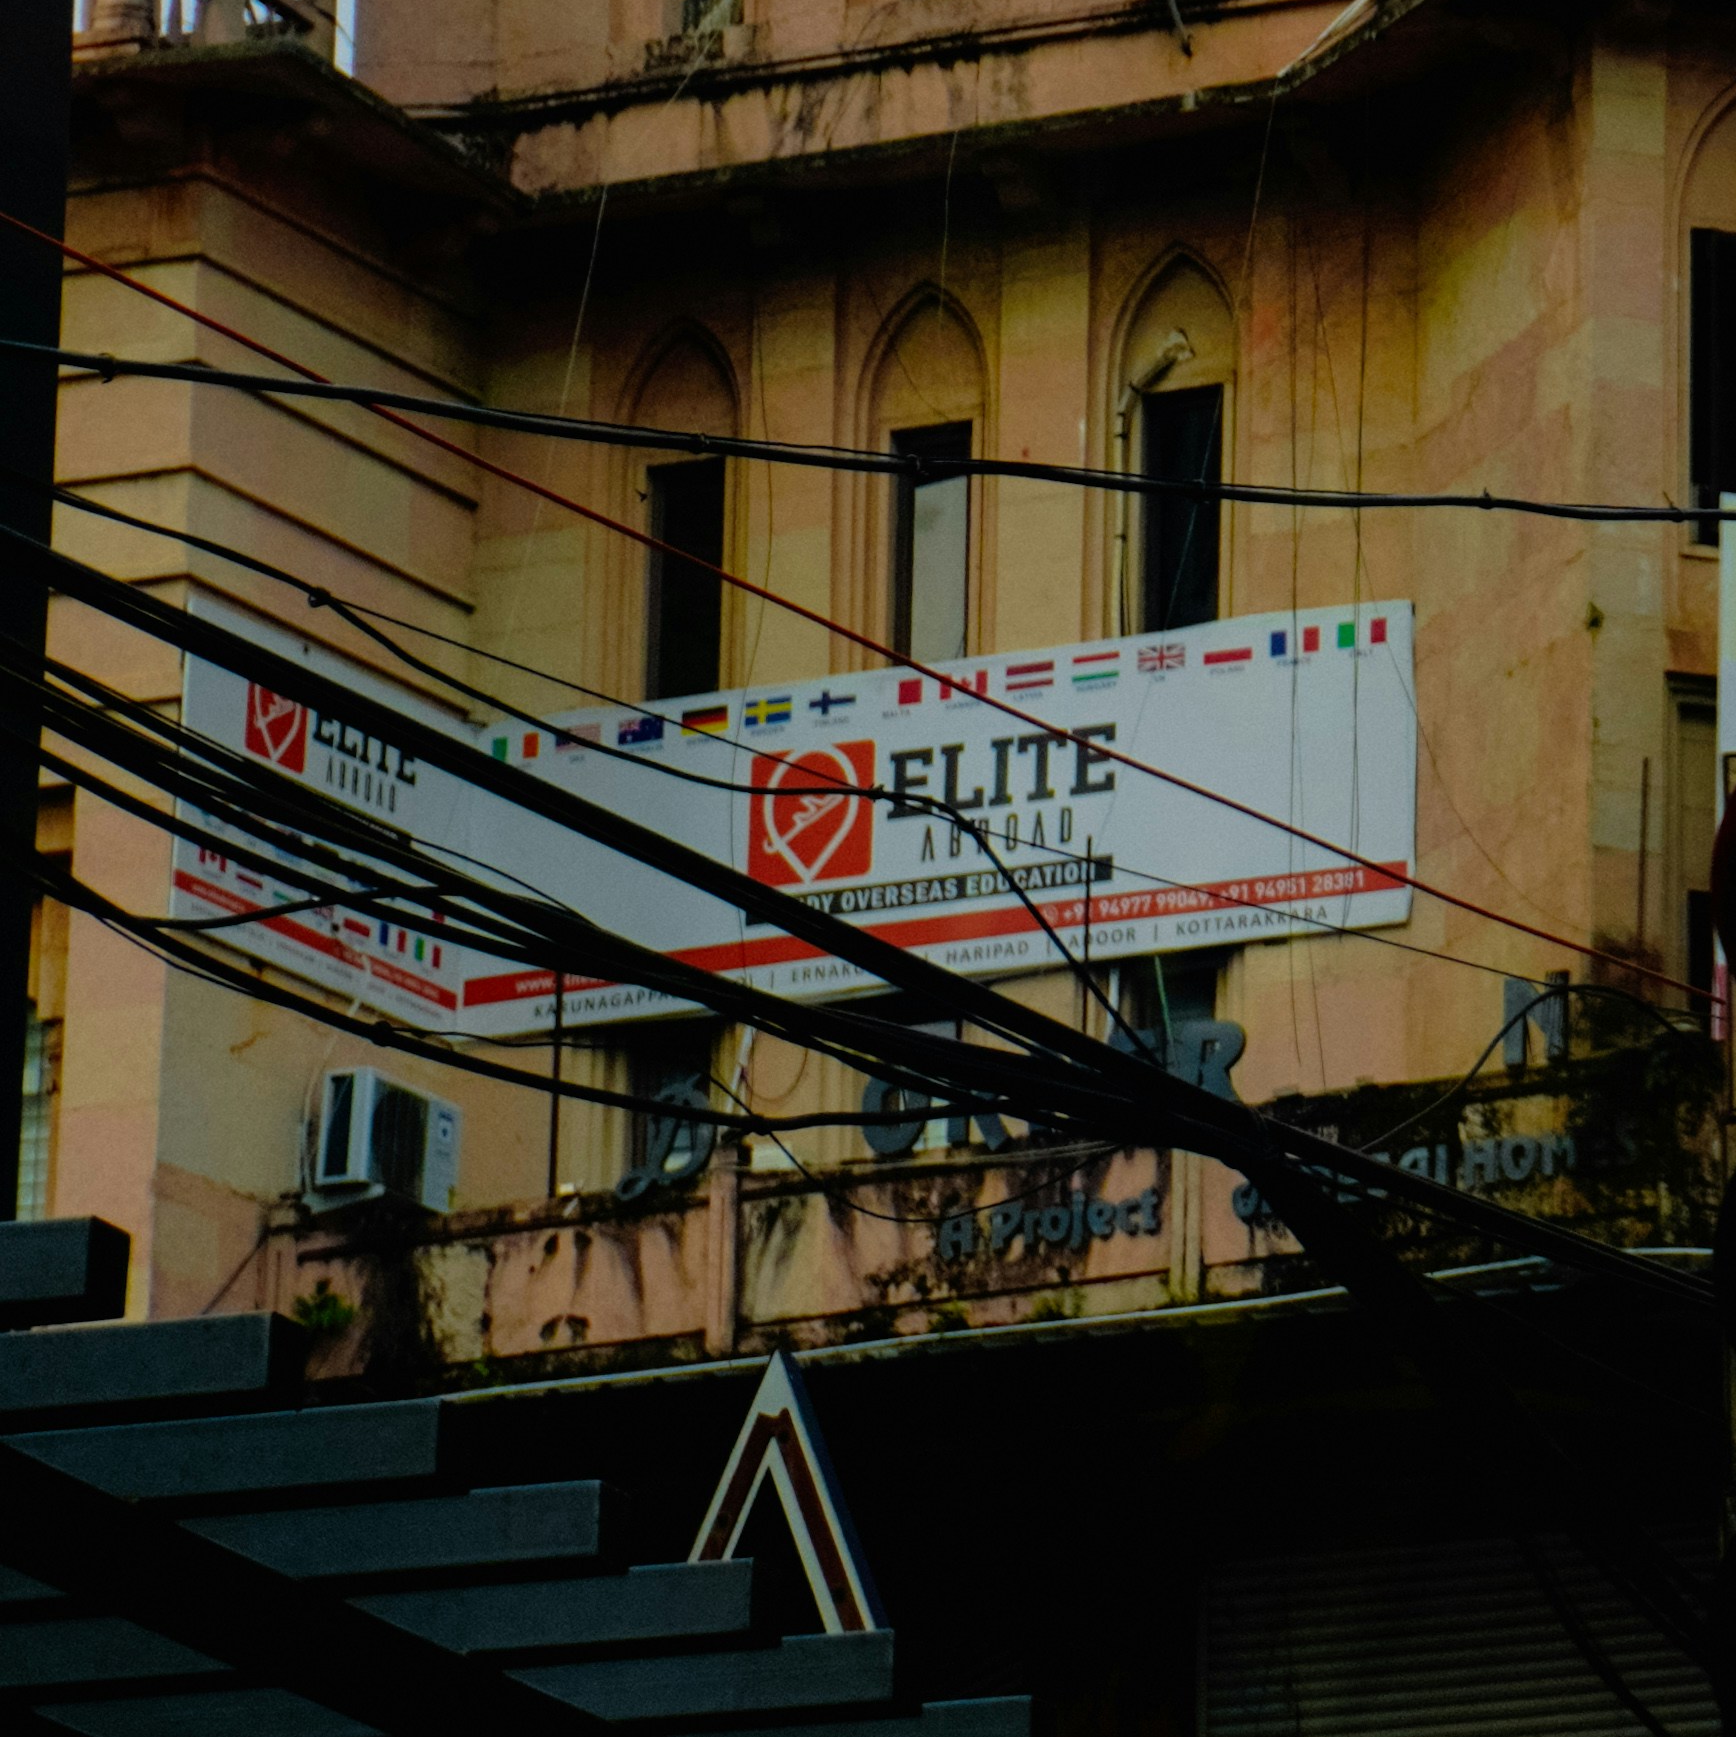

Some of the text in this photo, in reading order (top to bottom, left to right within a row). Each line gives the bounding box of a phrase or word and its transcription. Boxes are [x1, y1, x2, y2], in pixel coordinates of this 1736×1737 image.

[888, 723, 1116, 820] ELITE
[841, 878, 958, 910] OVERSEAS
[1098, 895, 1152, 918] 94977
[946, 940, 1029, 964] HARIPAD
[939, 1188, 1162, 1261] A Project
